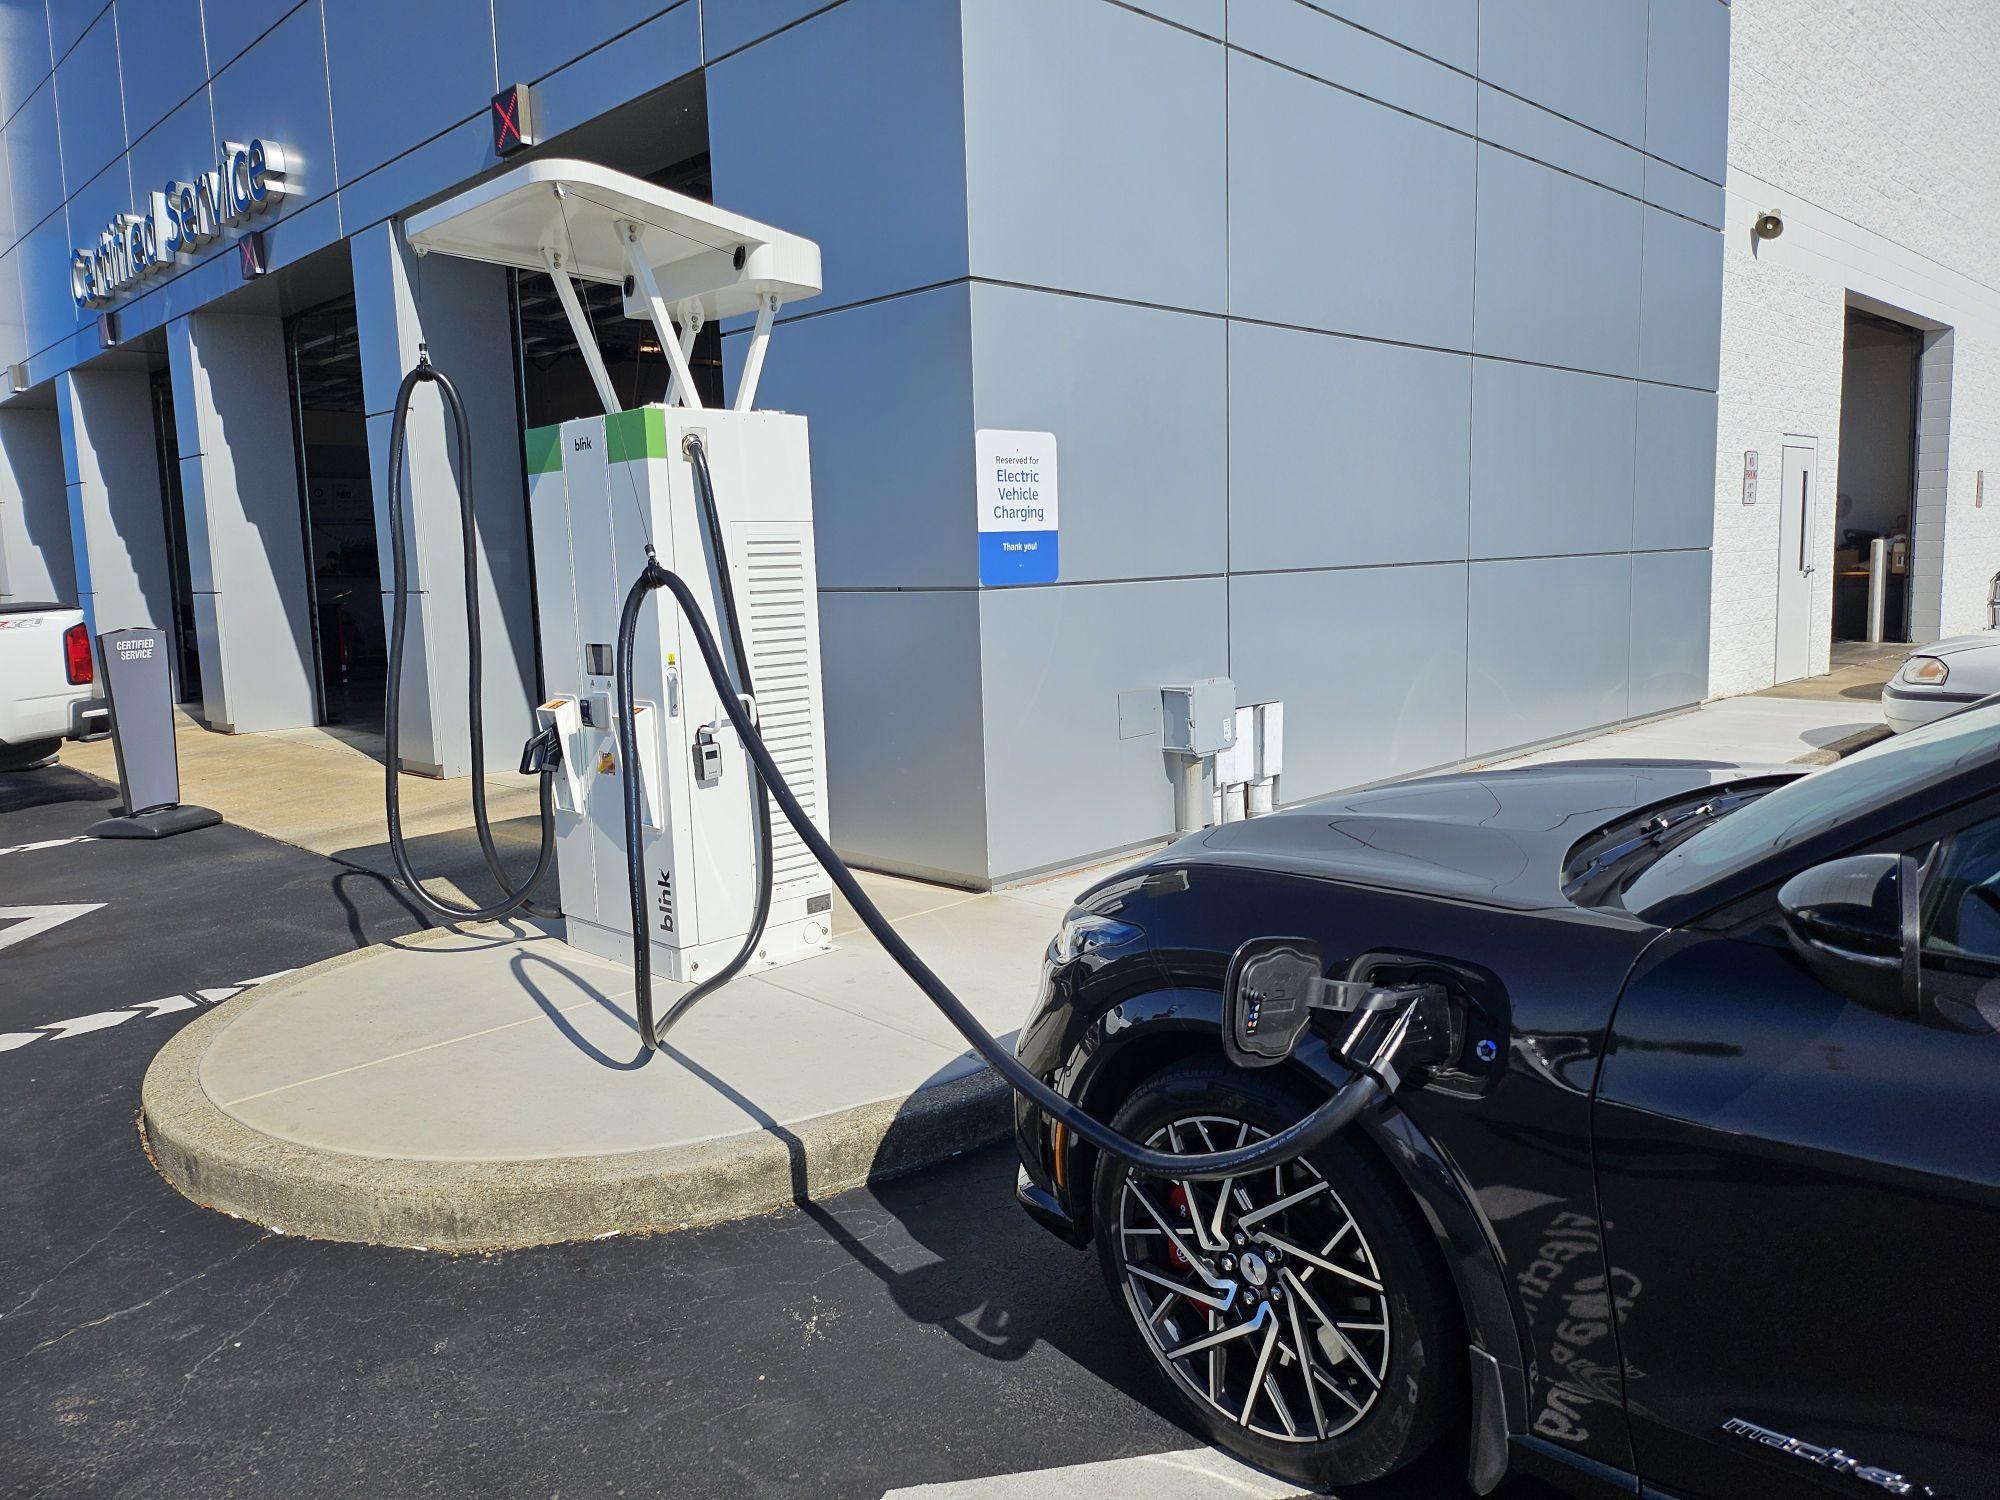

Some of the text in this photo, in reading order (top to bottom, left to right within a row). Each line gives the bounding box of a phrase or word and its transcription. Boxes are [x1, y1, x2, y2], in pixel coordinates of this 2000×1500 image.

[71, 138, 281, 308] Certified Service
[574, 436, 592, 451] blink
[996, 456, 1039, 464] Reserved for
[997, 469, 1039, 482] Electric
[998, 488, 1038, 500] Vehicle
[994, 506, 1043, 521] Charging
[1003, 542, 1037, 552] Thank you!
[117, 639, 154, 650] CERTIFIED
[121, 649, 153, 661] SERVICE
[657, 867, 674, 933] blink
